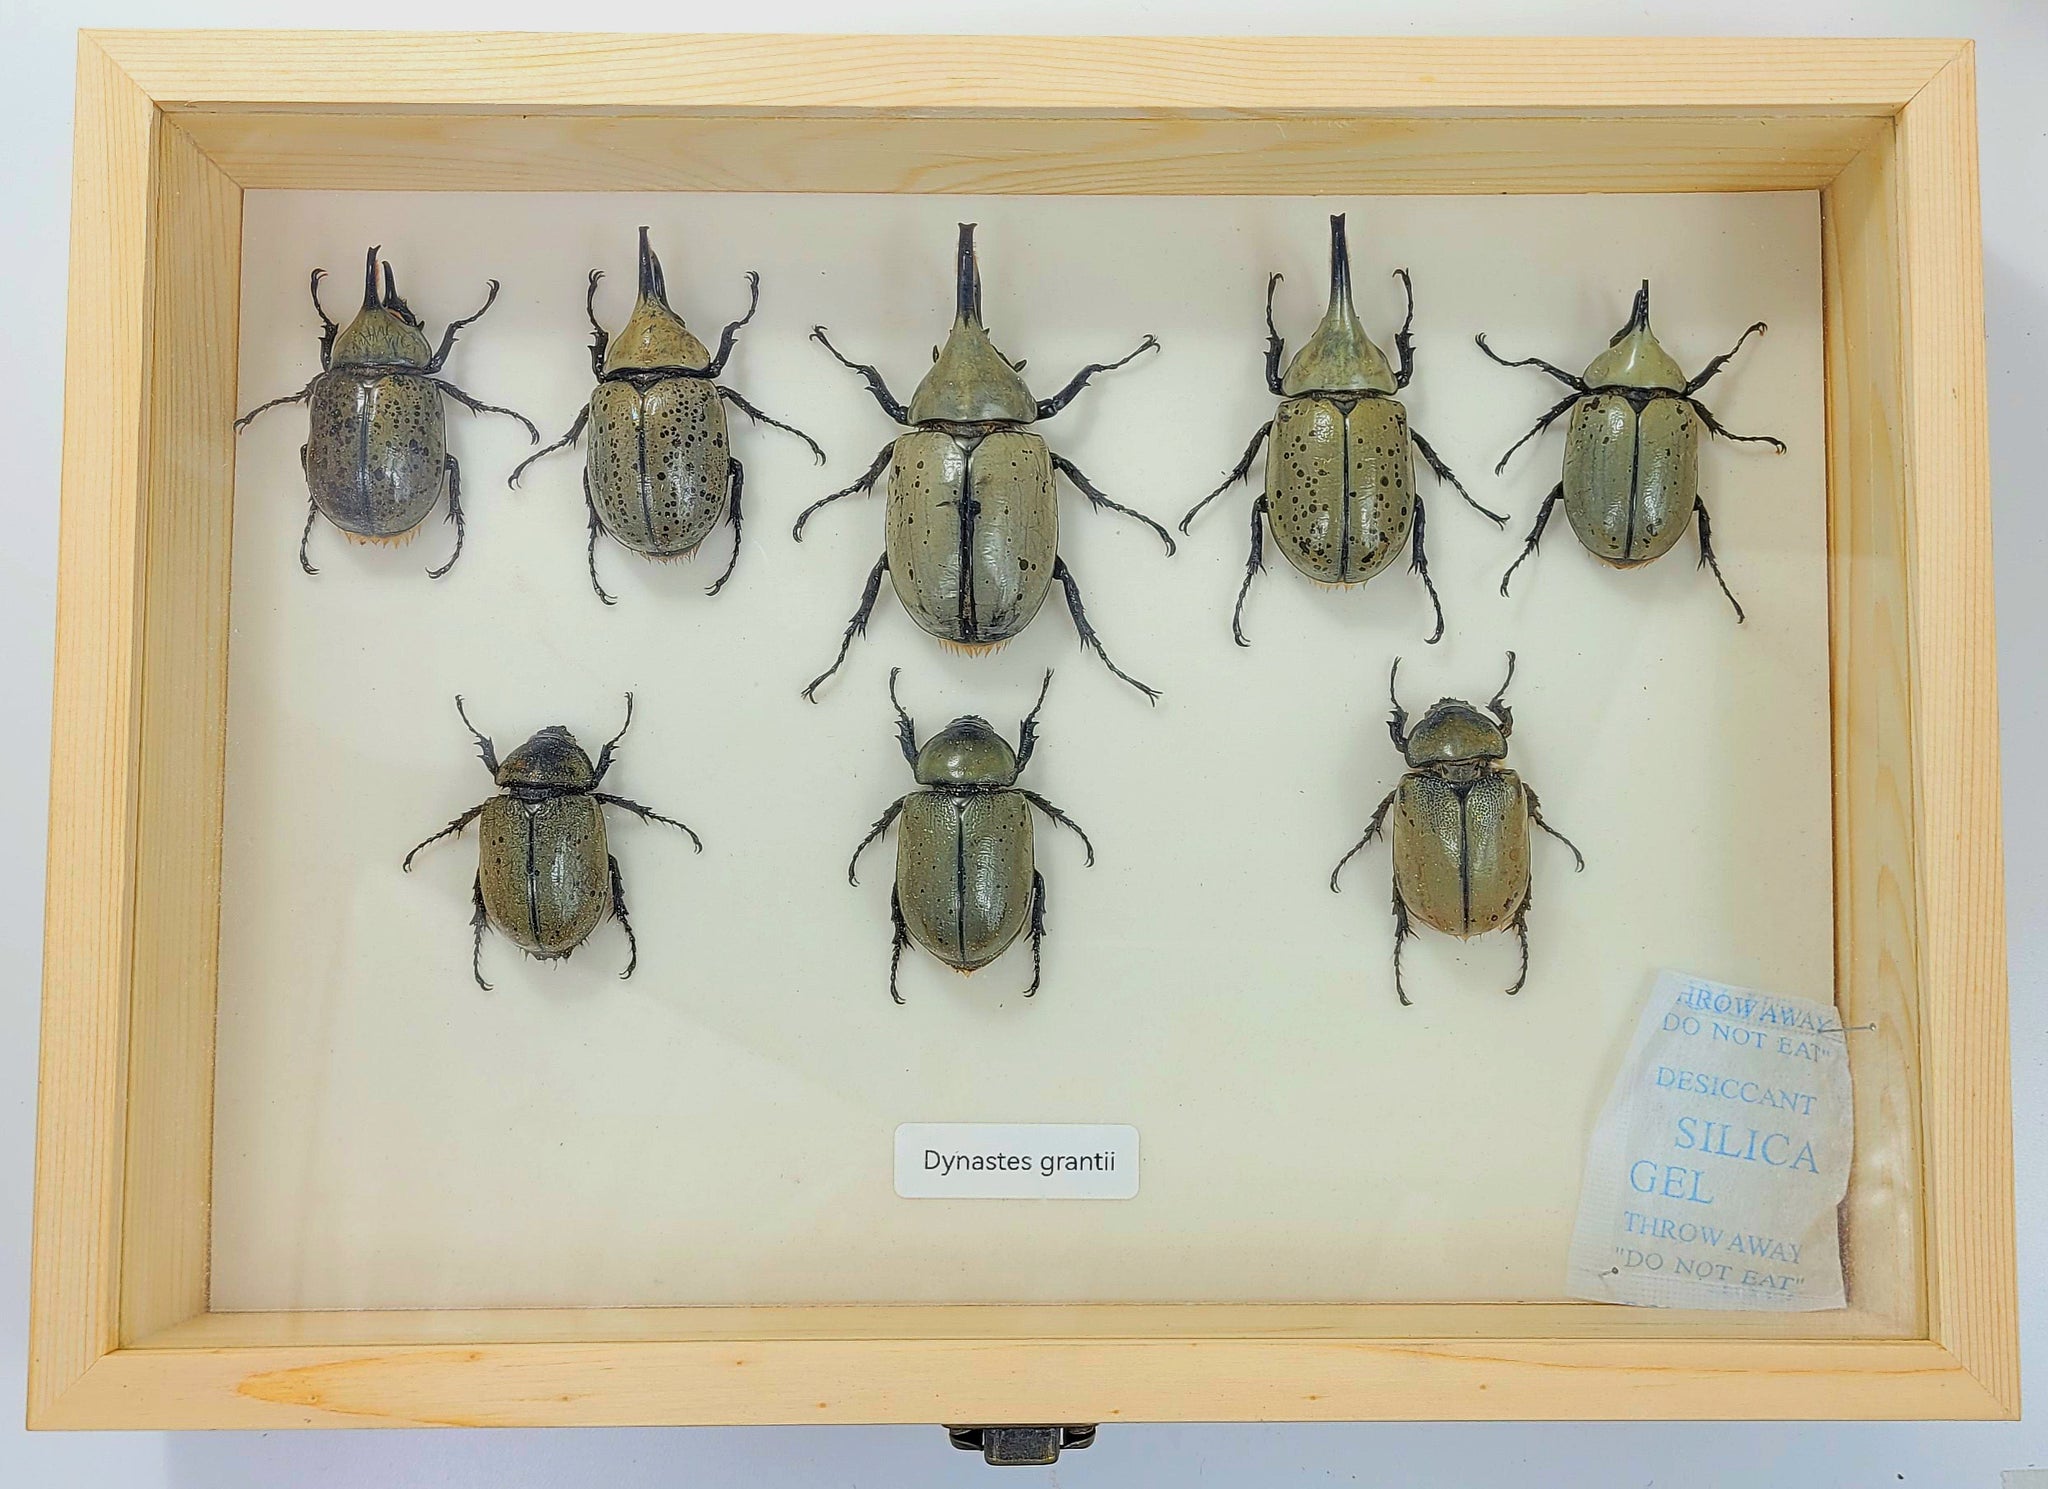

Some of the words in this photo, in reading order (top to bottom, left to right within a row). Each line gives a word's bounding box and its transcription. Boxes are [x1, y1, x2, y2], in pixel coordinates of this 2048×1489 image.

[1663, 1012, 1700, 1036] DO
[1712, 1022, 1767, 1048] NOT
[1759, 1004, 1832, 1034] AWAY
[1655, 1066, 1817, 1116] DESICCANT
[924, 1150, 1032, 1176] Dynastes
[1040, 1152, 1116, 1177] grantii
[1674, 1116, 1820, 1174] SILICA
[1630, 1160, 1713, 1204] GEL
[1624, 1211, 1724, 1247] THROW
[1727, 1233, 1802, 1264] AWAY
[1674, 1256, 1733, 1281] NOT
